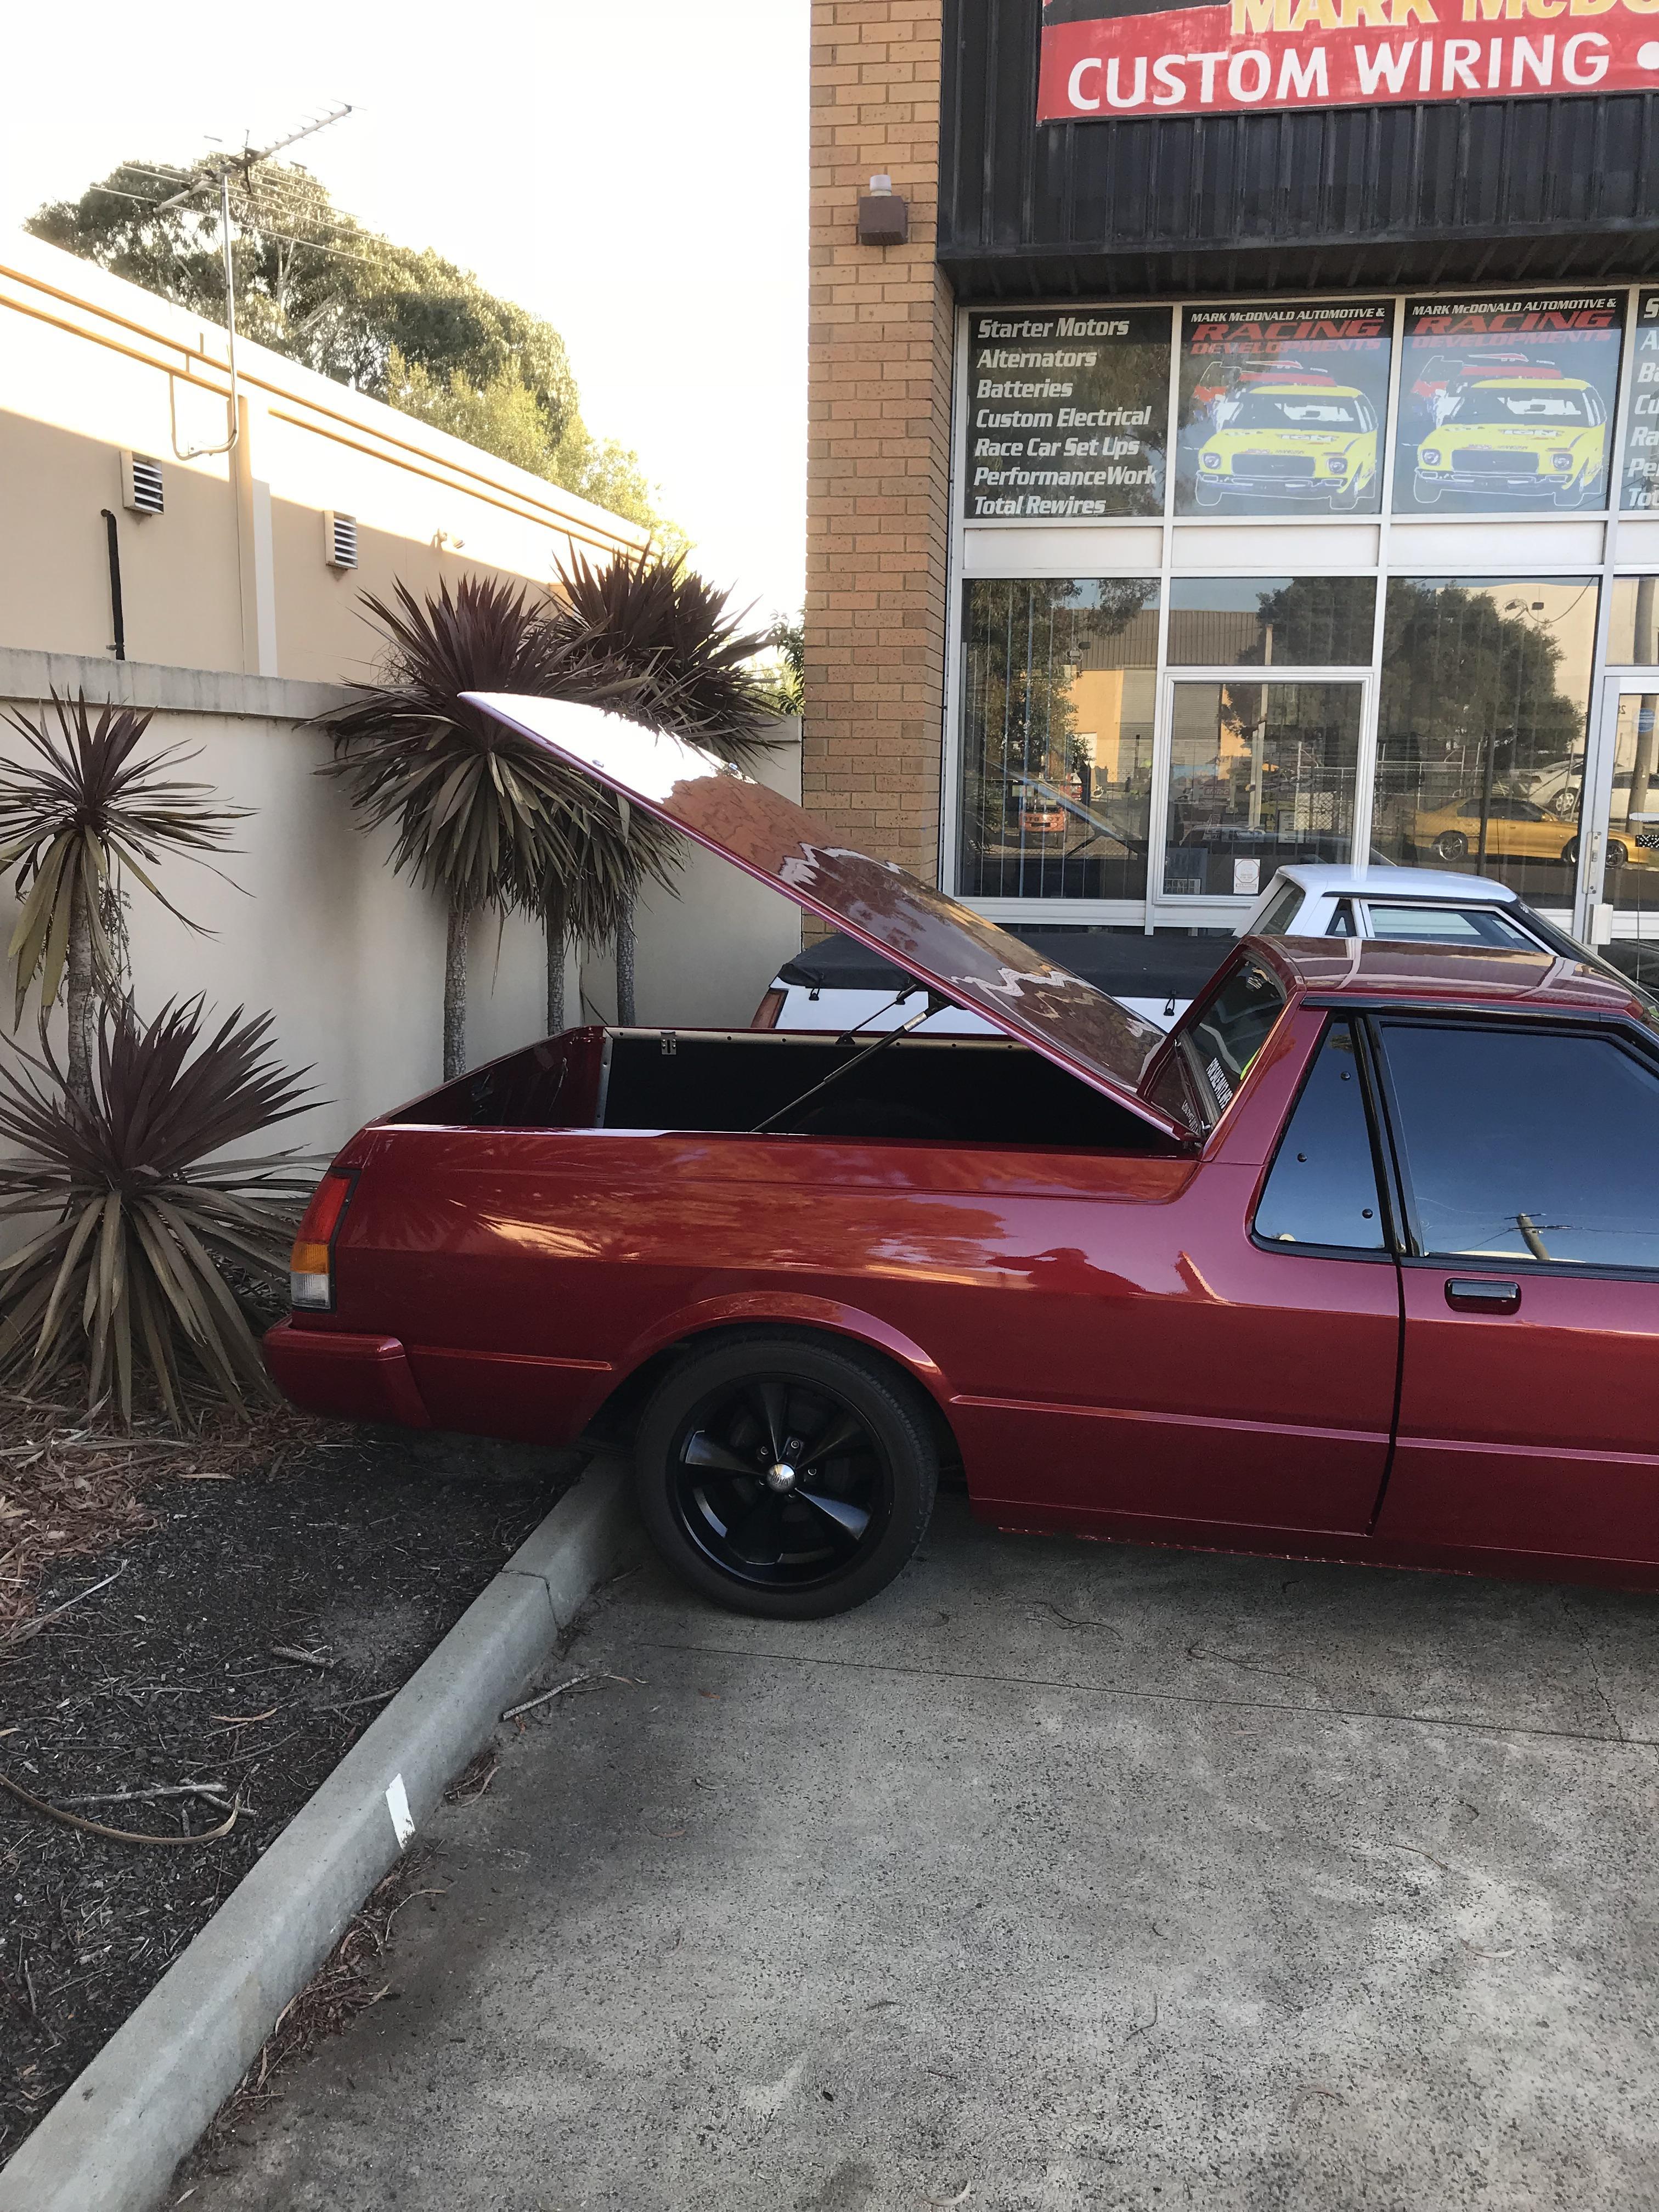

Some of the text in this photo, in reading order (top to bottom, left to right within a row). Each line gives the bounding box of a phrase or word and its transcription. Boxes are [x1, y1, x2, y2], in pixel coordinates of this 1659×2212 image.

[1068, 32, 1610, 110] CUSTOM WIRING
[1190, 308, 1385, 323] MARK McDONALD AUTOMOTIVE &
[1412, 298, 1617, 315] MARK McDONALD AUTOMOTIVE &
[978, 317, 1130, 338] Starter Motors
[1191, 319, 1385, 341] RACING
[1412, 309, 1616, 335] RACING
[1190, 339, 1381, 355] DEVELOPMENTS
[1412, 329, 1612, 348] DEVELOPMENTS
[977, 349, 1097, 368] Alternators
[977, 379, 1074, 398] Batteries
[976, 406, 1152, 427] Custom Electrical
[975, 437, 1140, 460] Race Car Set Ups
[975, 495, 1107, 515] Total Rewires
[1206, 1057, 1220, 1078] FOR
[1209, 1065, 1224, 1089] SALE
